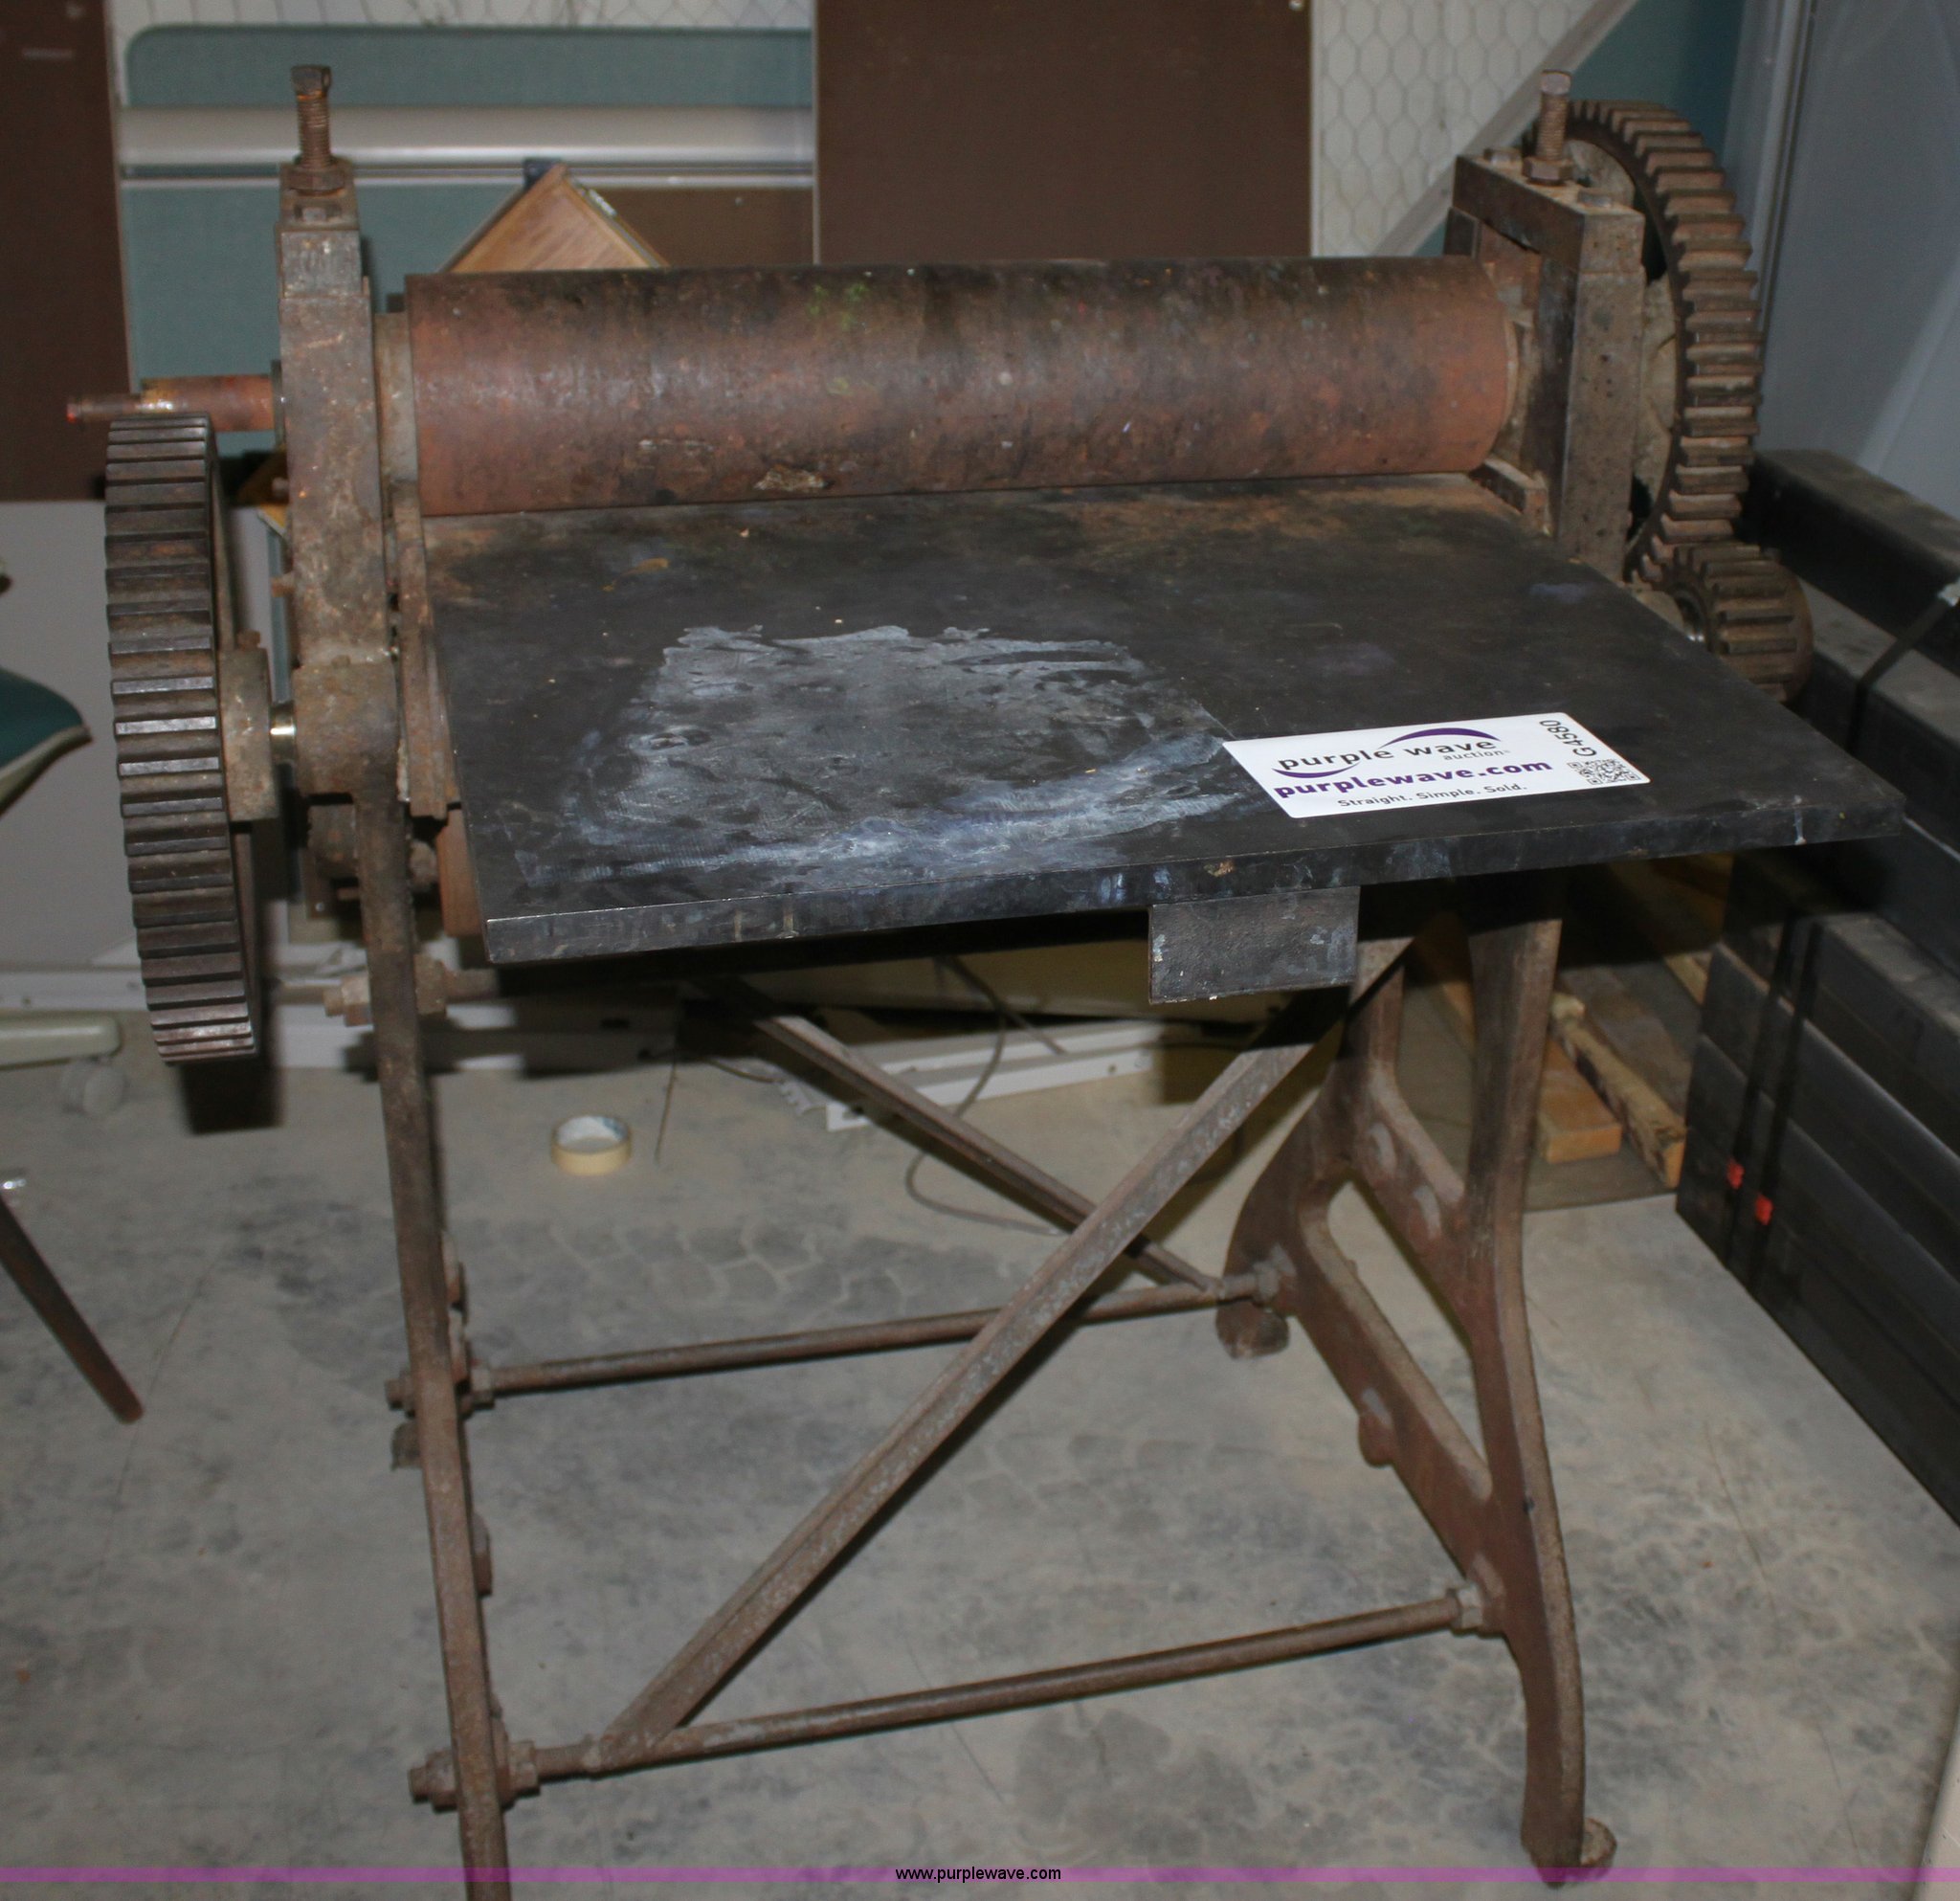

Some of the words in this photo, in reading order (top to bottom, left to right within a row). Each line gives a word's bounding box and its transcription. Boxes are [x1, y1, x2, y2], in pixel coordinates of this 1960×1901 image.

[1539, 720, 1597, 756] G4580
[1278, 749, 1394, 771] purple
[1404, 741, 1497, 756] wave
[1274, 761, 1553, 798] purplewave.com
[1338, 794, 1413, 807] Straight.
[1416, 789, 1481, 800] Simple.
[1483, 782, 1526, 794] Sold.
